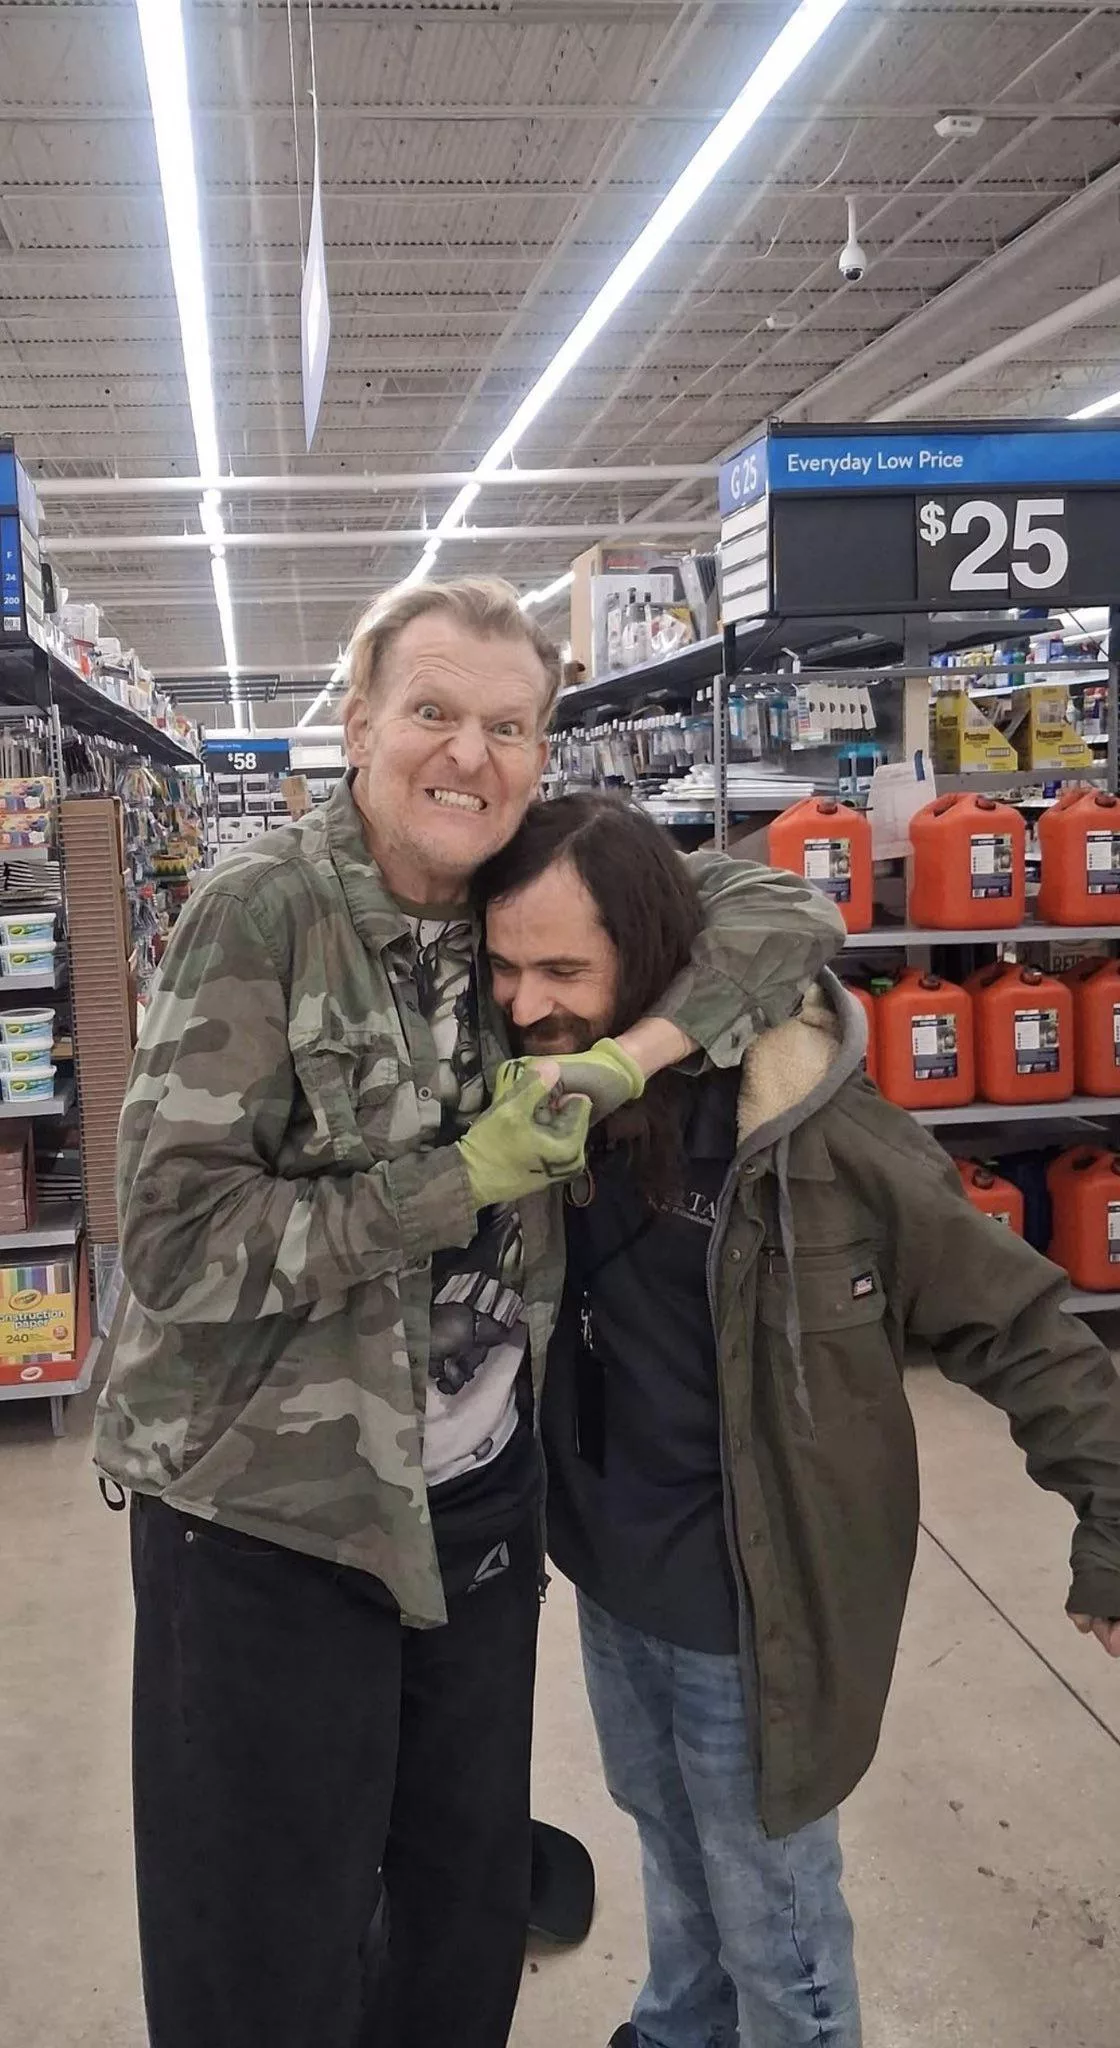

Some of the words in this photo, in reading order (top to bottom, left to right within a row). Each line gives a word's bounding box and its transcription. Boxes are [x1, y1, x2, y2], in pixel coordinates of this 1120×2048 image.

[743, 454, 757, 494] 25
[787, 452, 872, 476] Everyday
[877, 452, 913, 470] Low
[919, 450, 964, 469] Price
[6, 551, 13, 559] F
[919, 498, 1069, 592] $25
[228, 752, 257, 770] $58
[6, 1334, 29, 1344] 240
